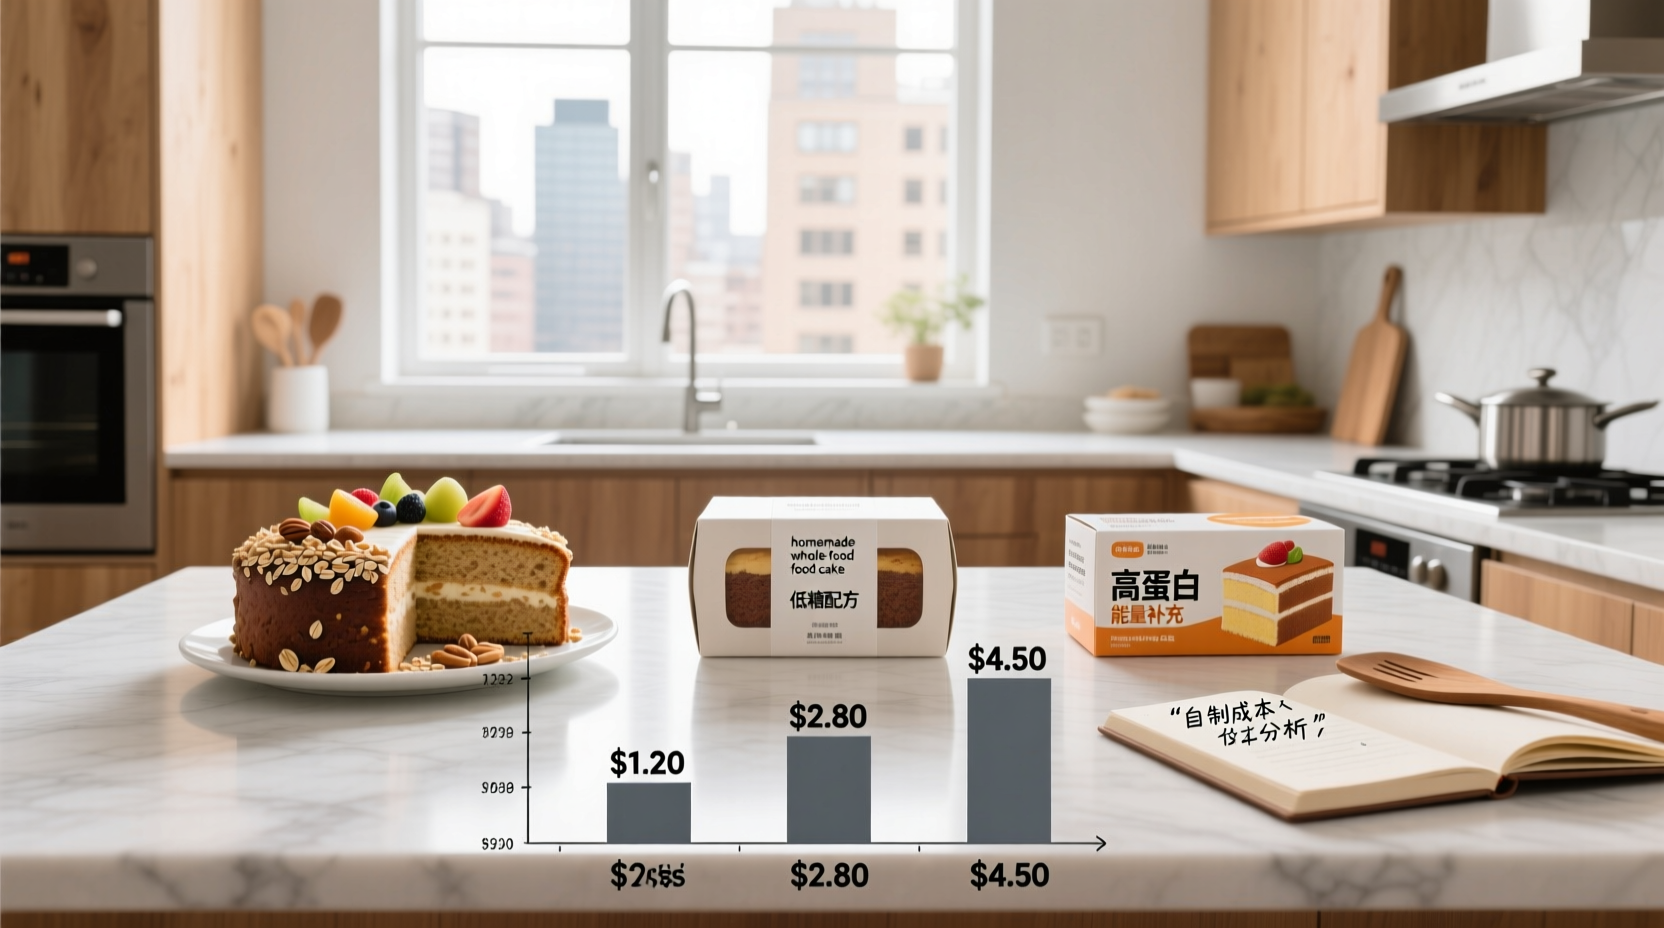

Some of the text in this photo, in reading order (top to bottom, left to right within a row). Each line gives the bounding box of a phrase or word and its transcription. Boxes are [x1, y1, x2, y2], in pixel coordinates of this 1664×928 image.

[791, 535, 856, 548] homemade
[829, 549, 855, 561] food
[790, 562, 845, 575] food cake
[1111, 568, 1199, 602] 高蛋白
[1111, 604, 1185, 625] 能量补充
